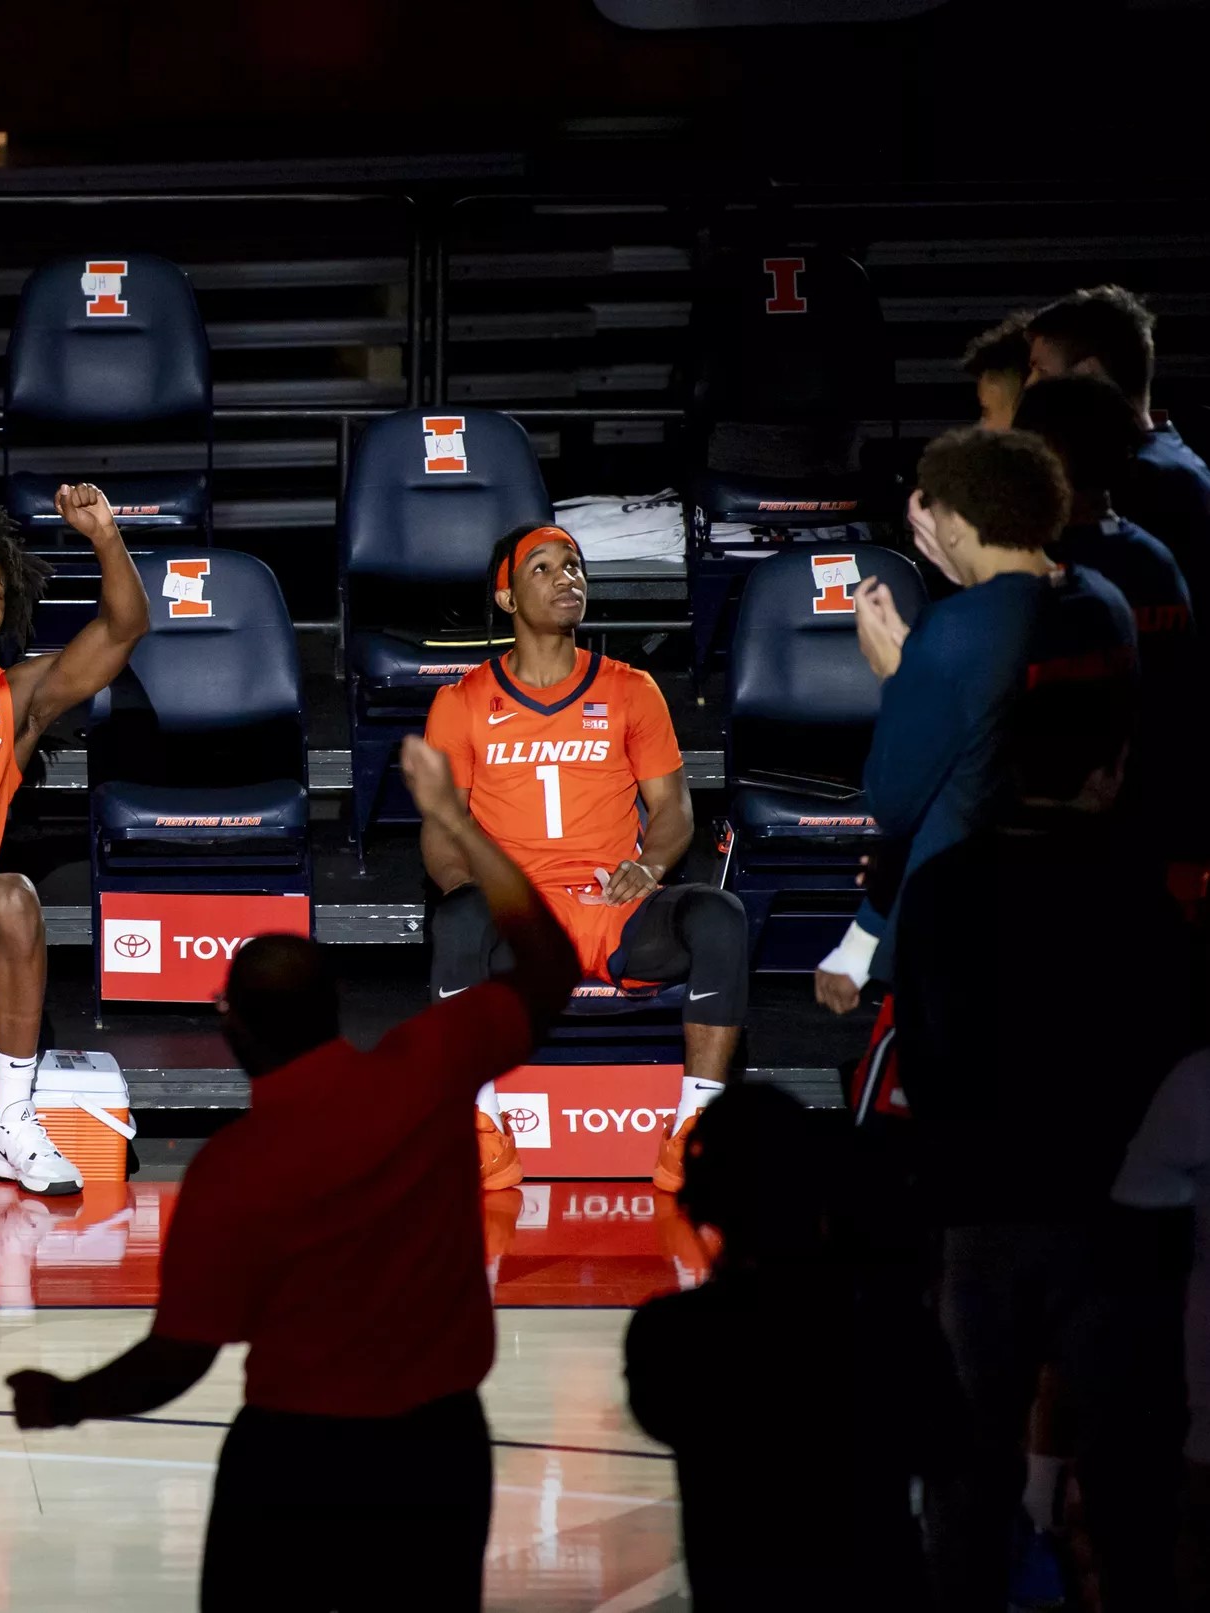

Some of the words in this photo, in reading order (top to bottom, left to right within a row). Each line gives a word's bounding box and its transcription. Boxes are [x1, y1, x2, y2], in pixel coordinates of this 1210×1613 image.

[435, 438, 454, 454] KJ
[822, 567, 845, 583] GA
[172, 580, 194, 596] AF
[486, 741, 610, 765] ILLINOIS
[535, 765, 563, 838] 1
[156, 816, 220, 827] FIGHTING
[221, 816, 262, 827] ILLINI
[561, 1108, 676, 1133] TOYOT
